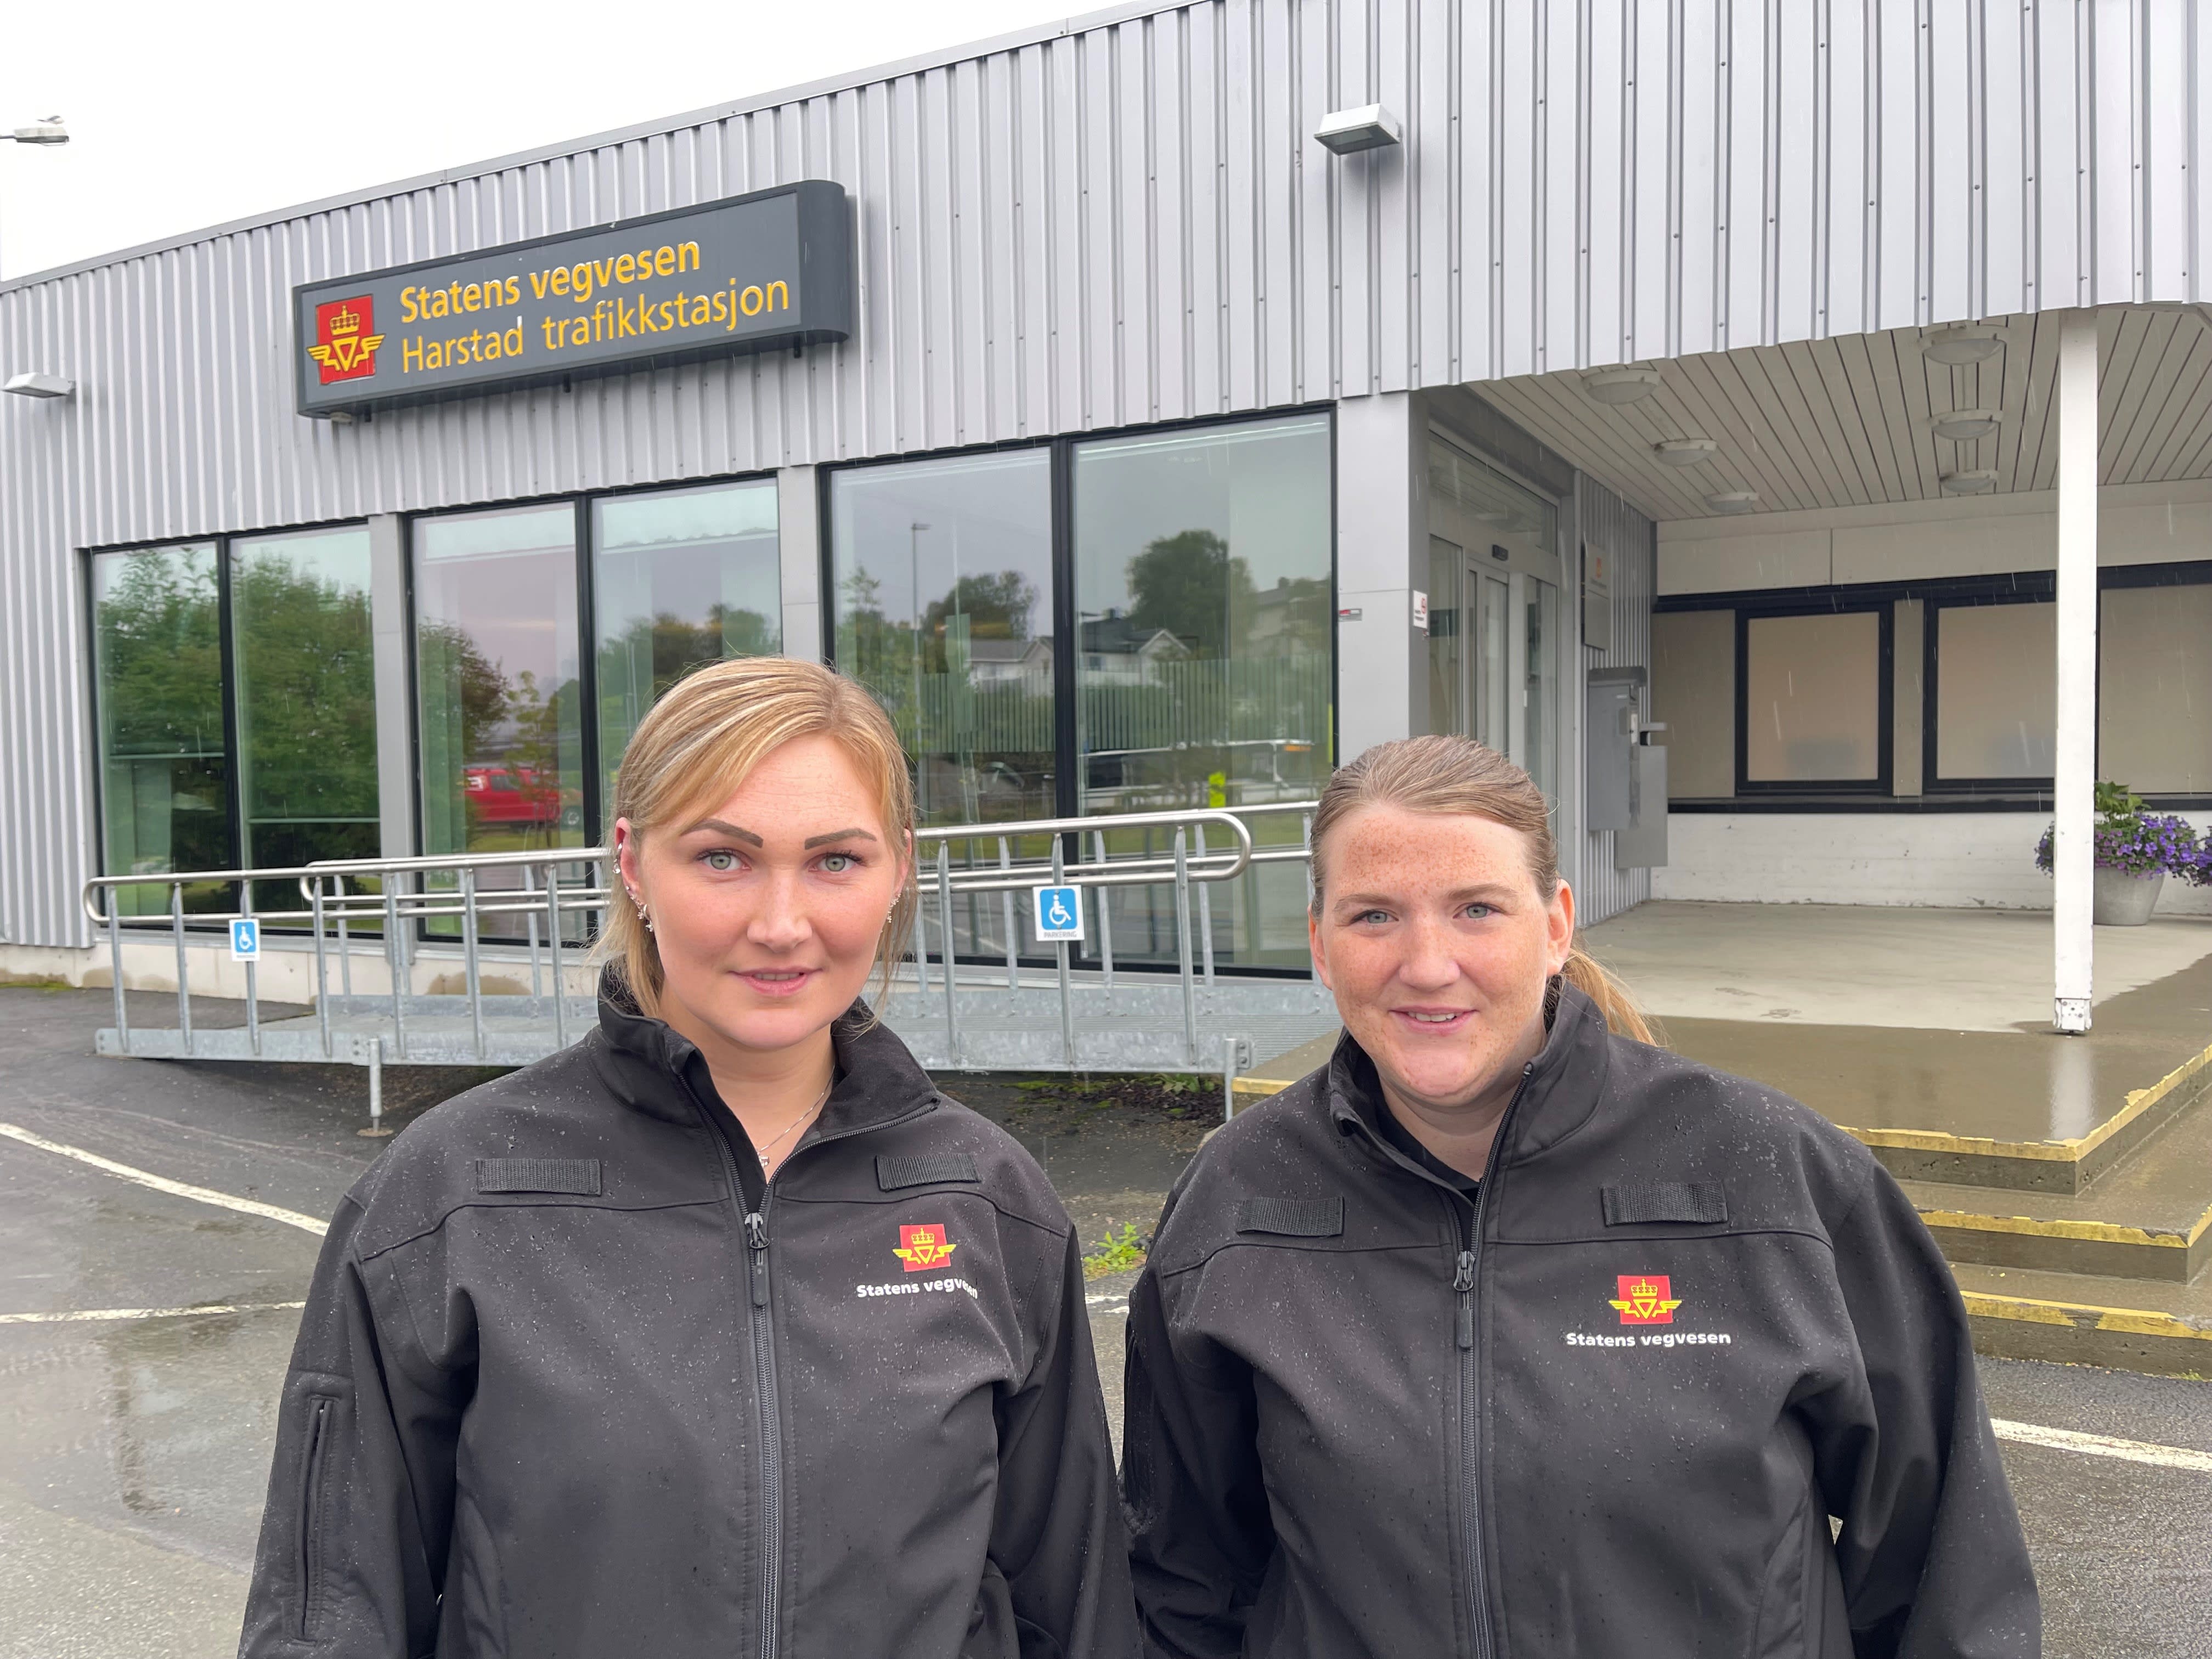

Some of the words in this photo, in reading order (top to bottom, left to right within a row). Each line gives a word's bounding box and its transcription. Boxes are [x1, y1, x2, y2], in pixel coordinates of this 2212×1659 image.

[400, 275, 521, 323] Statens
[529, 241, 701, 302] vegvesen
[402, 315, 523, 374] Harstad
[541, 278, 789, 350] trafikkstasjon
[856, 1283, 920, 1298] Statens
[1566, 1333, 1636, 1347] Statens
[1640, 1333, 1731, 1347] vegvesen
